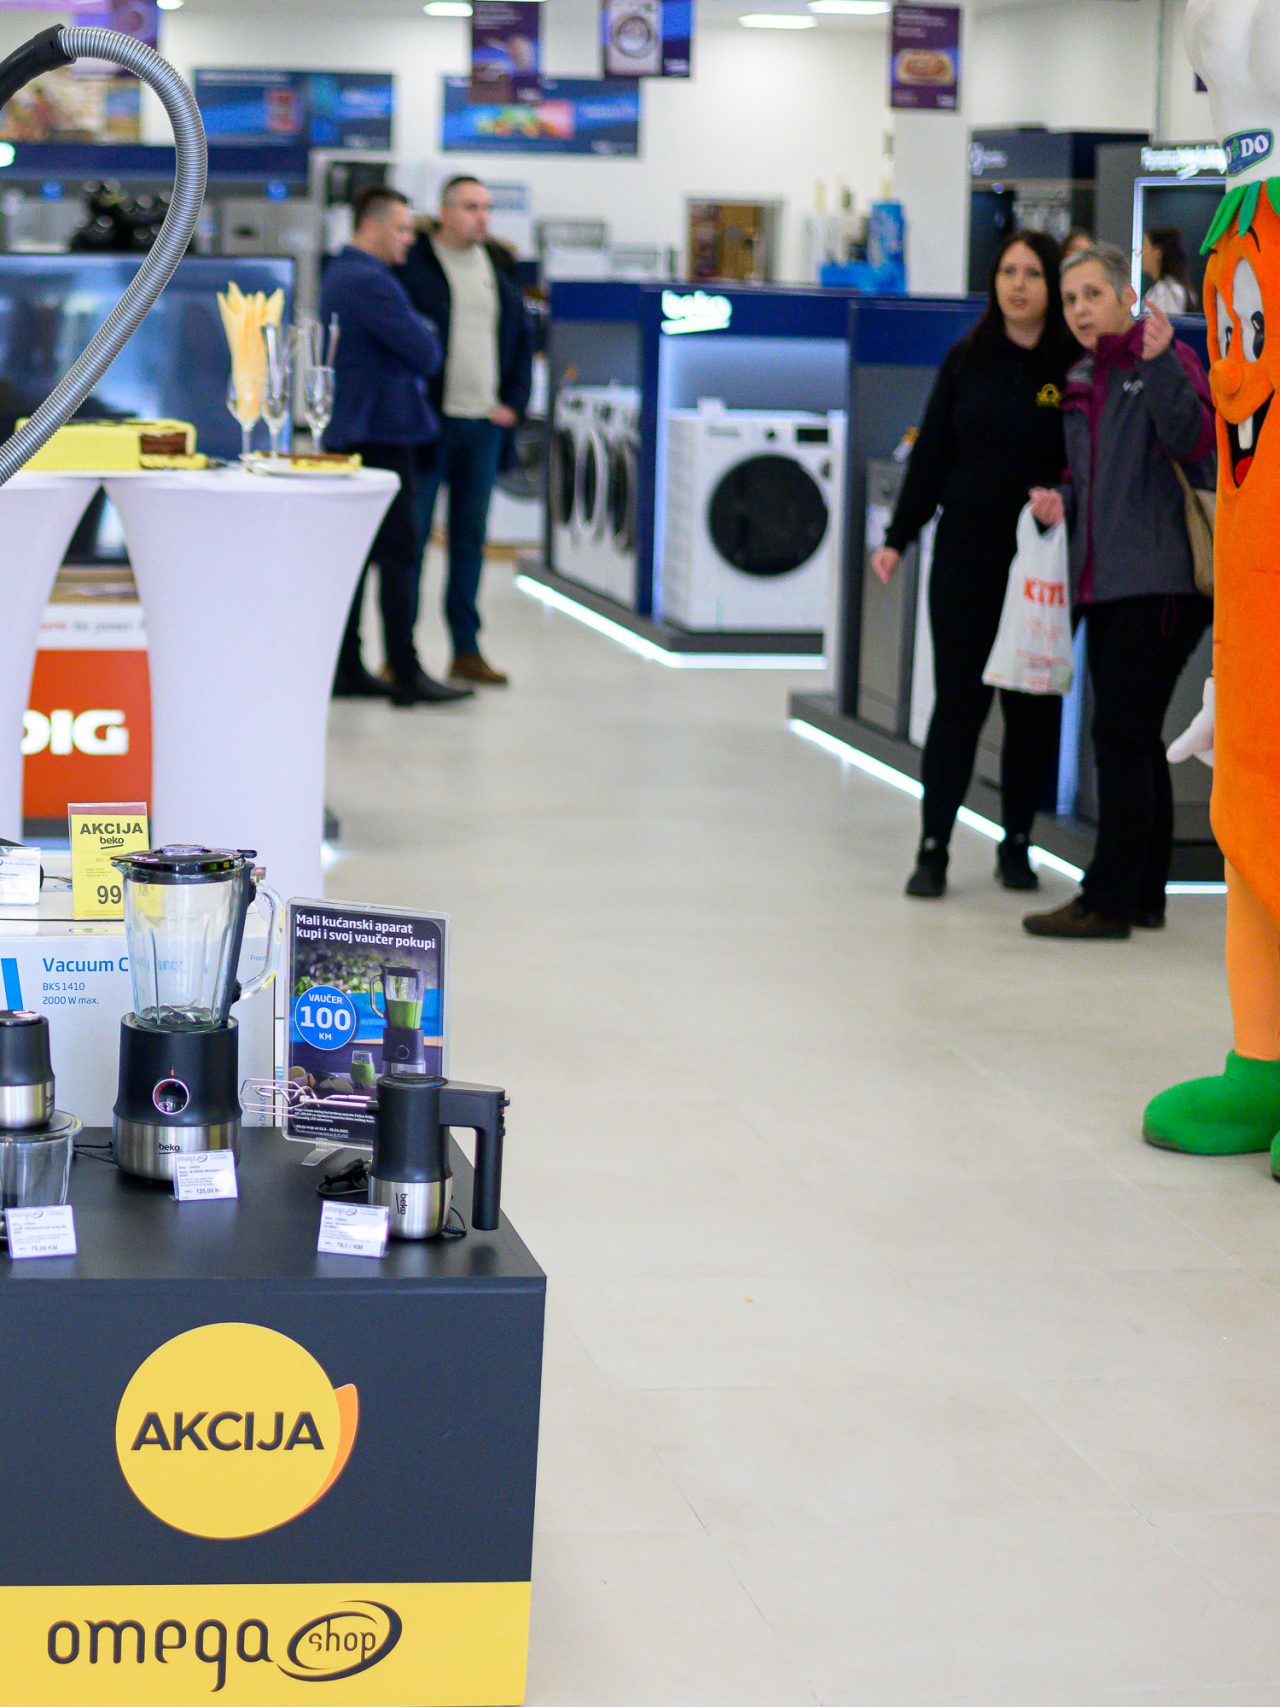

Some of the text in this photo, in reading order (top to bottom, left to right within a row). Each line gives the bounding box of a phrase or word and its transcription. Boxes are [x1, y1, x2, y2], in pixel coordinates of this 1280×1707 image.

[80, 823, 143, 834] AKCIJA
[100, 836, 124, 845] beko
[296, 914, 413, 934] Mali kućanski aparat
[296, 928, 436, 950] kupi i svoj vaučer pokupi
[43, 958, 113, 972] Vacuum
[308, 993, 343, 1004] VAUČER
[300, 1006, 351, 1030] 100
[318, 1033, 332, 1041] KM
[158, 1143, 180, 1152] beko
[399, 1193, 408, 1215] beko
[131, 1411, 324, 1451] AKCIJA
[47, 1618, 376, 1693] omega shop
